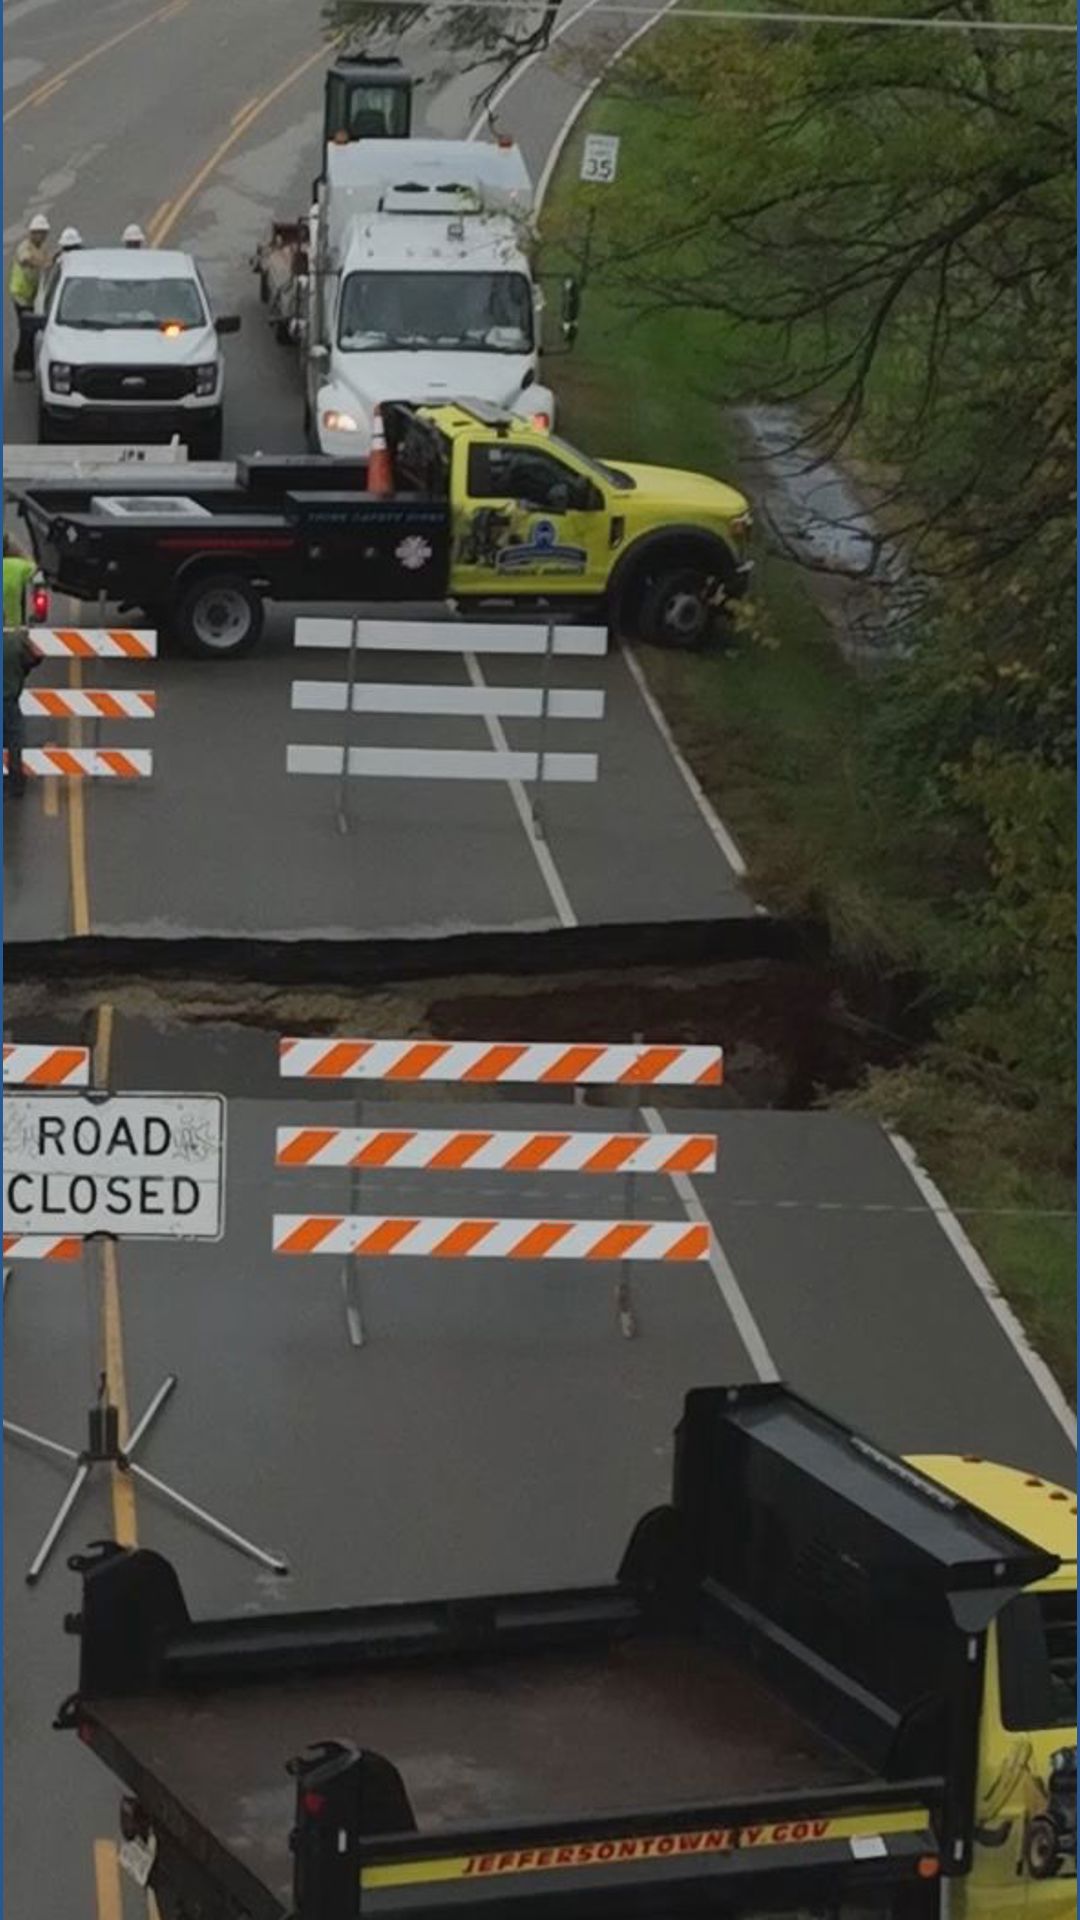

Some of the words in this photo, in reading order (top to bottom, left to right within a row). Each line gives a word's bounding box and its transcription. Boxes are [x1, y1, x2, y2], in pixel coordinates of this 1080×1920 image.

[585, 158, 613, 179] 35
[38, 1115, 171, 1156] ROAD
[7, 1173, 200, 1215] CLOSED
